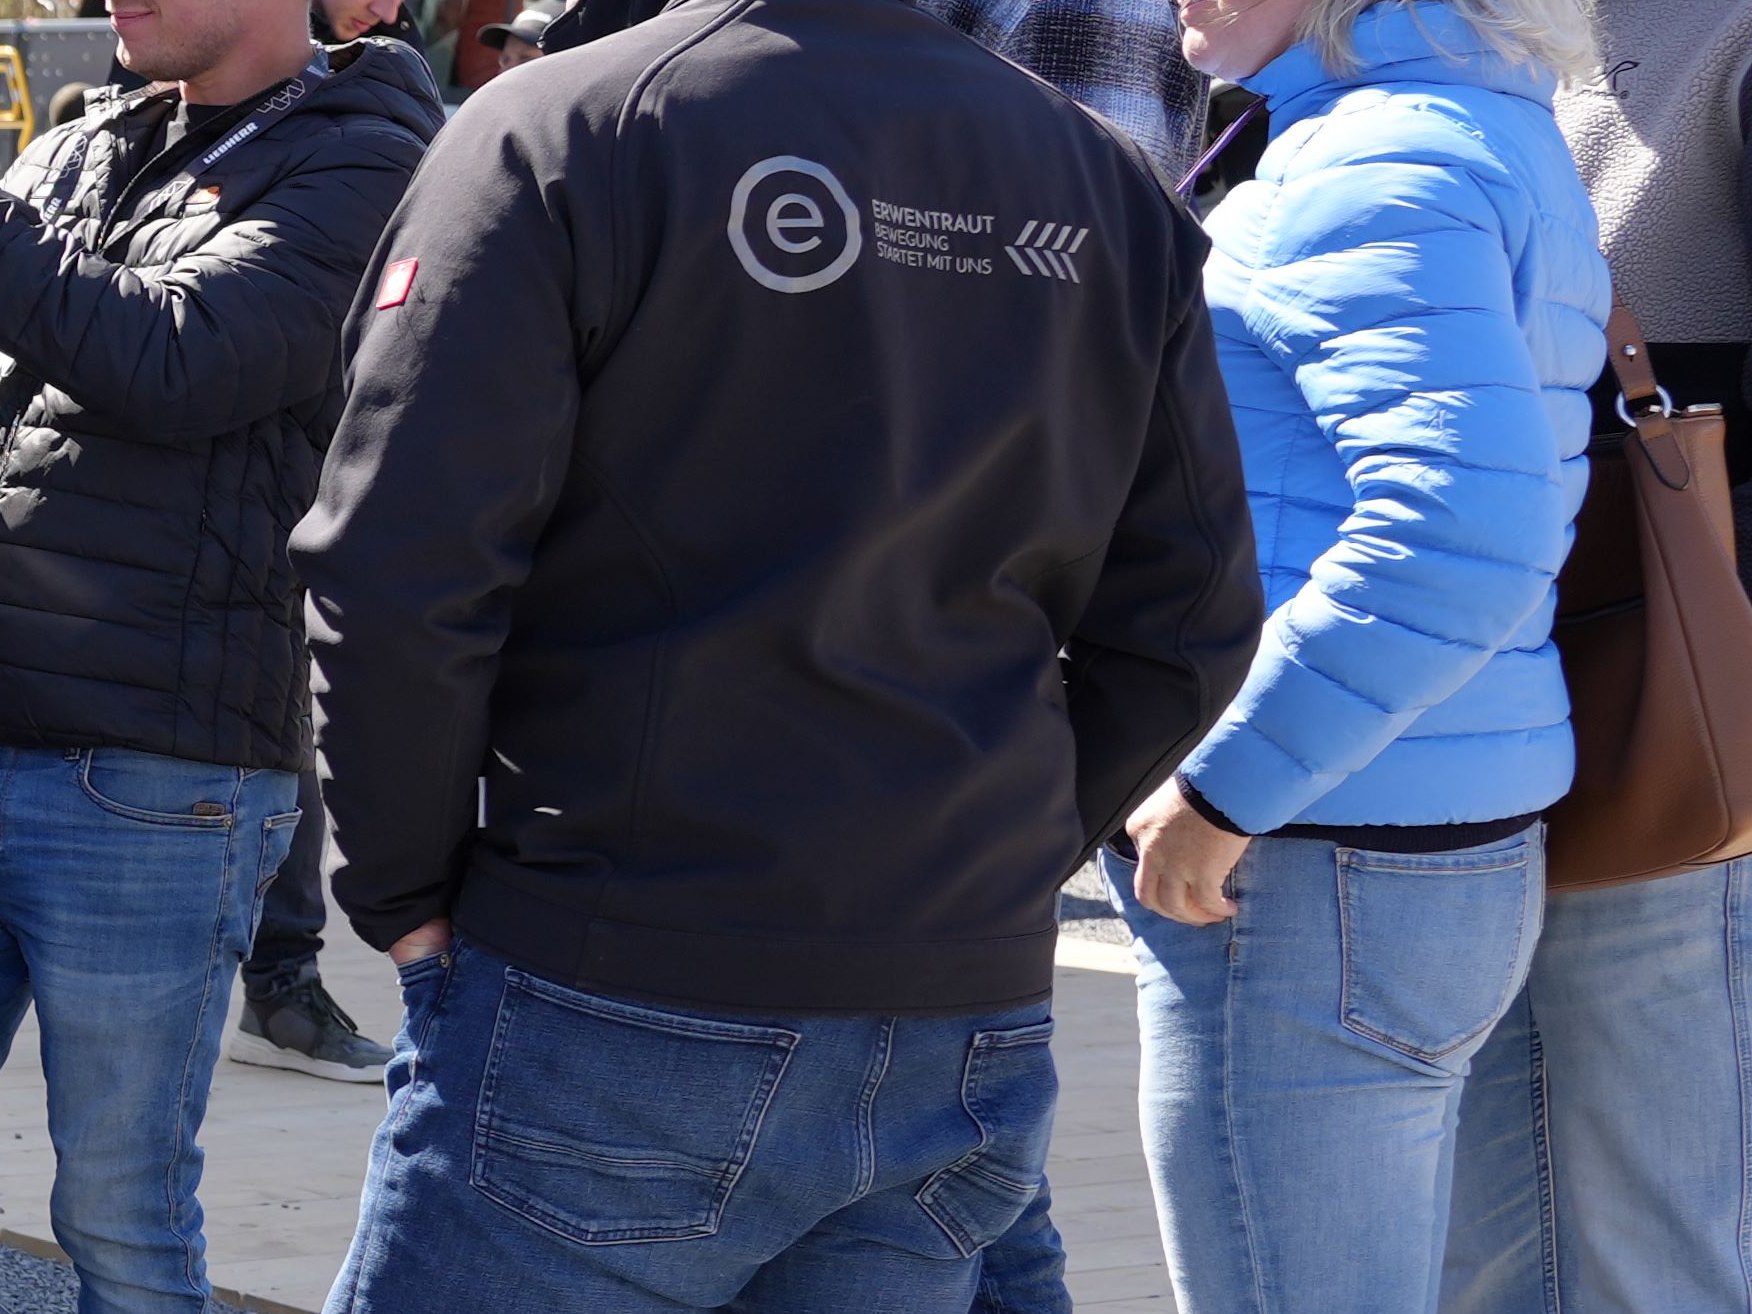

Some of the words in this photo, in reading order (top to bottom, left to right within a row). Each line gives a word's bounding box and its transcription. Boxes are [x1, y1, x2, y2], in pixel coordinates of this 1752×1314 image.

[202, 121, 259, 165] LIEBHERR
[871, 199, 995, 235] ERWENTRAUT
[874, 222, 949, 251] BEWEGUNG
[876, 241, 925, 268] STARTET
[927, 254, 951, 272] MIT
[955, 258, 993, 276] UNS
